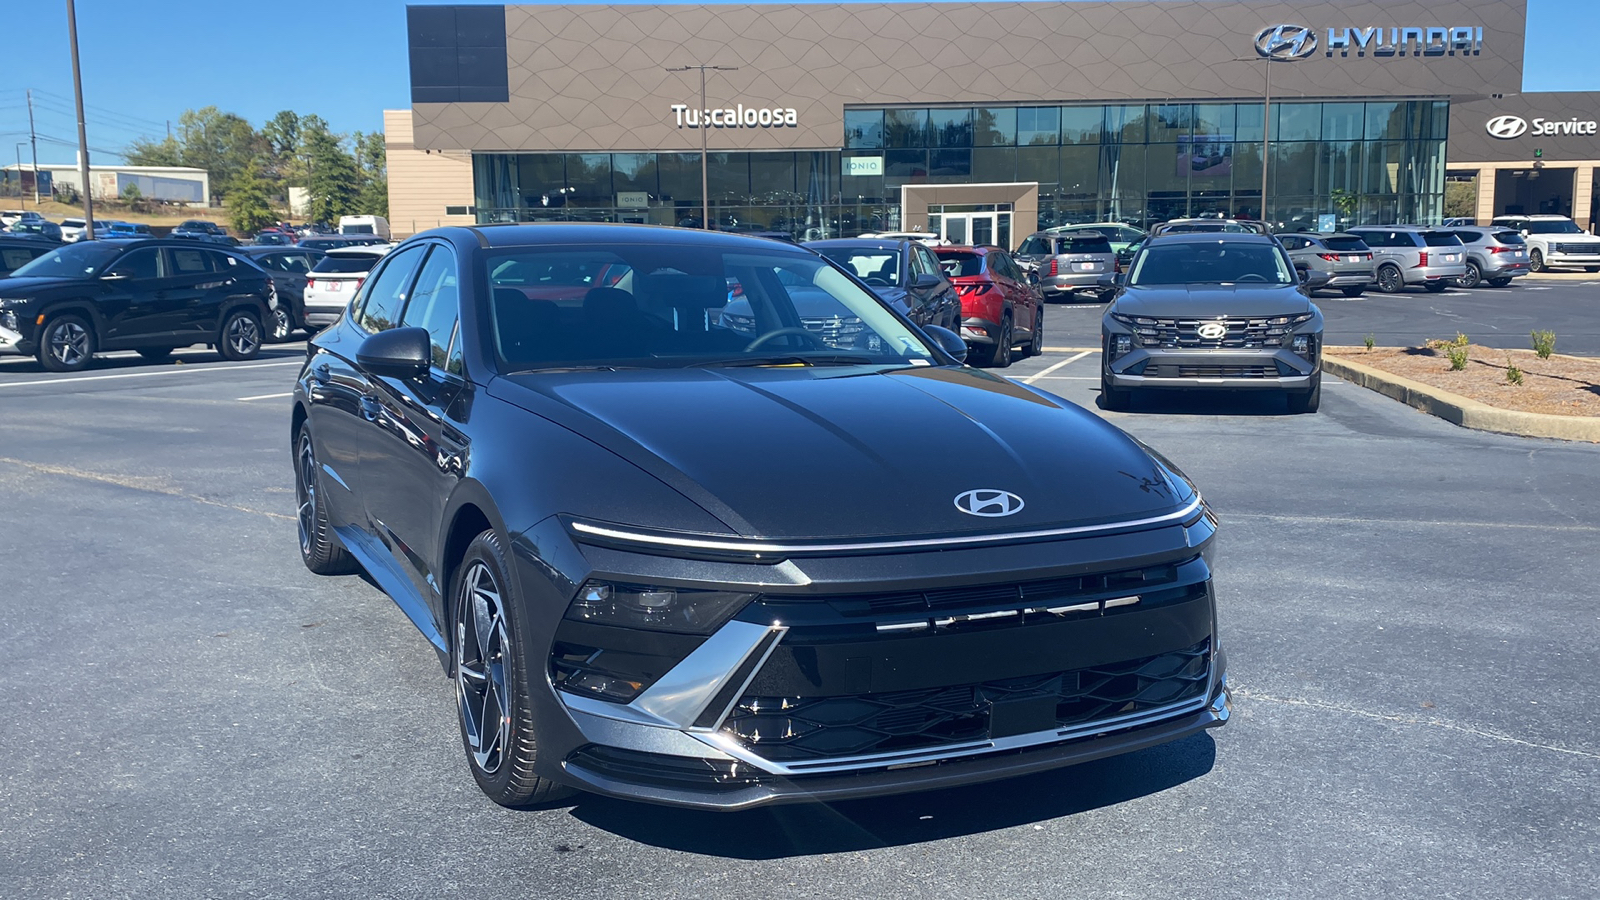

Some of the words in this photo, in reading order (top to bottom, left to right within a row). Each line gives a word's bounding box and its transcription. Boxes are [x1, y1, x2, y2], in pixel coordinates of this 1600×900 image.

[1327, 26, 1483, 56] HYUNDAI
[671, 103, 797, 127] Tuscaloosa
[1531, 117, 1597, 136] Service
[846, 162, 877, 170] IONIQ
